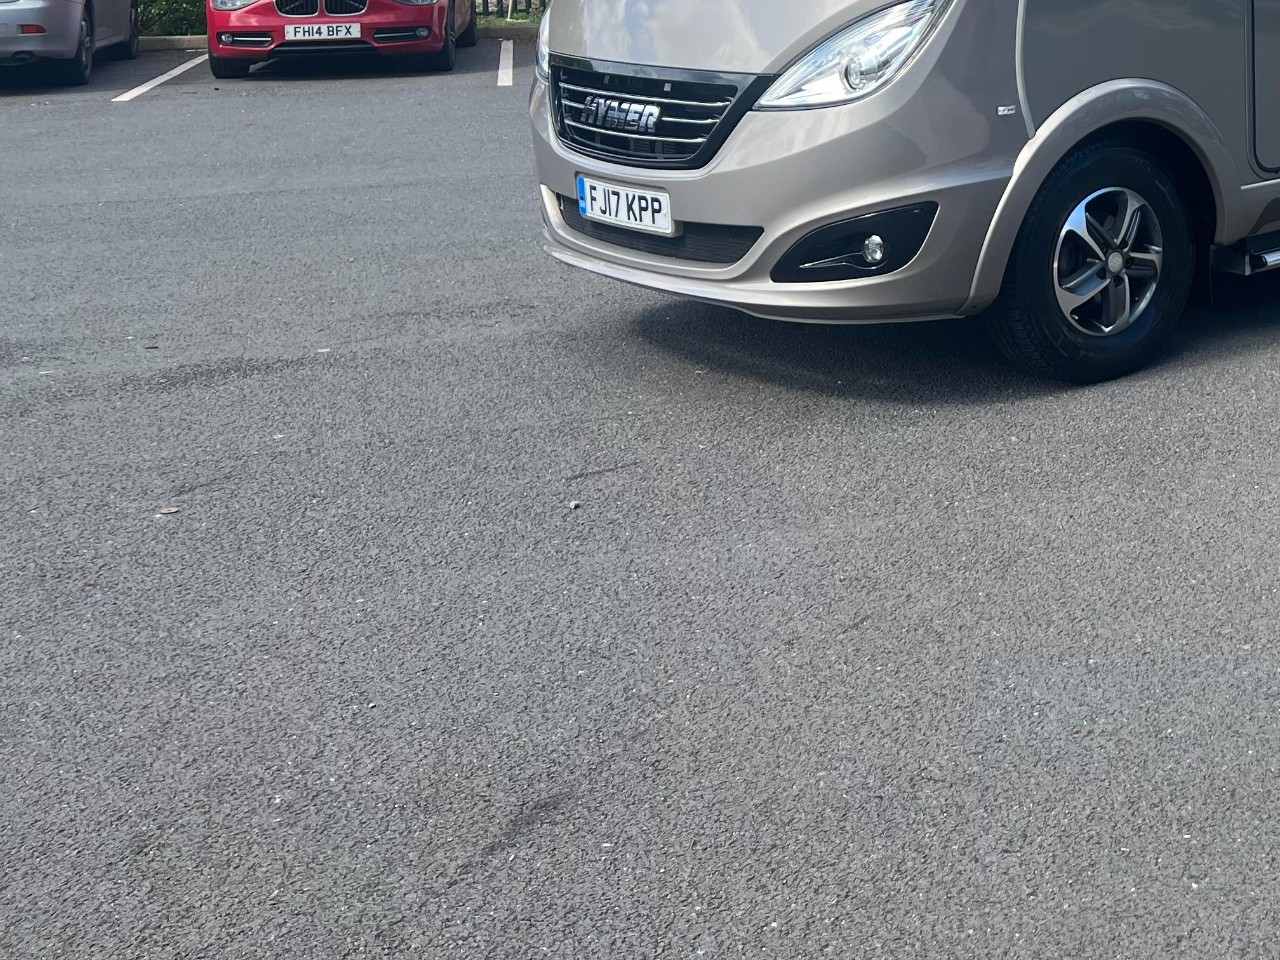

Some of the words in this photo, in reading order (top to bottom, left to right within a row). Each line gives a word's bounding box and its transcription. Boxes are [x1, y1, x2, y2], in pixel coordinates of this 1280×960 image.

[293, 26, 323, 38] FH14
[326, 25, 352, 37] BFX
[580, 95, 661, 133] HYMER
[589, 184, 621, 218] FJ17
[625, 192, 662, 225] KPP
